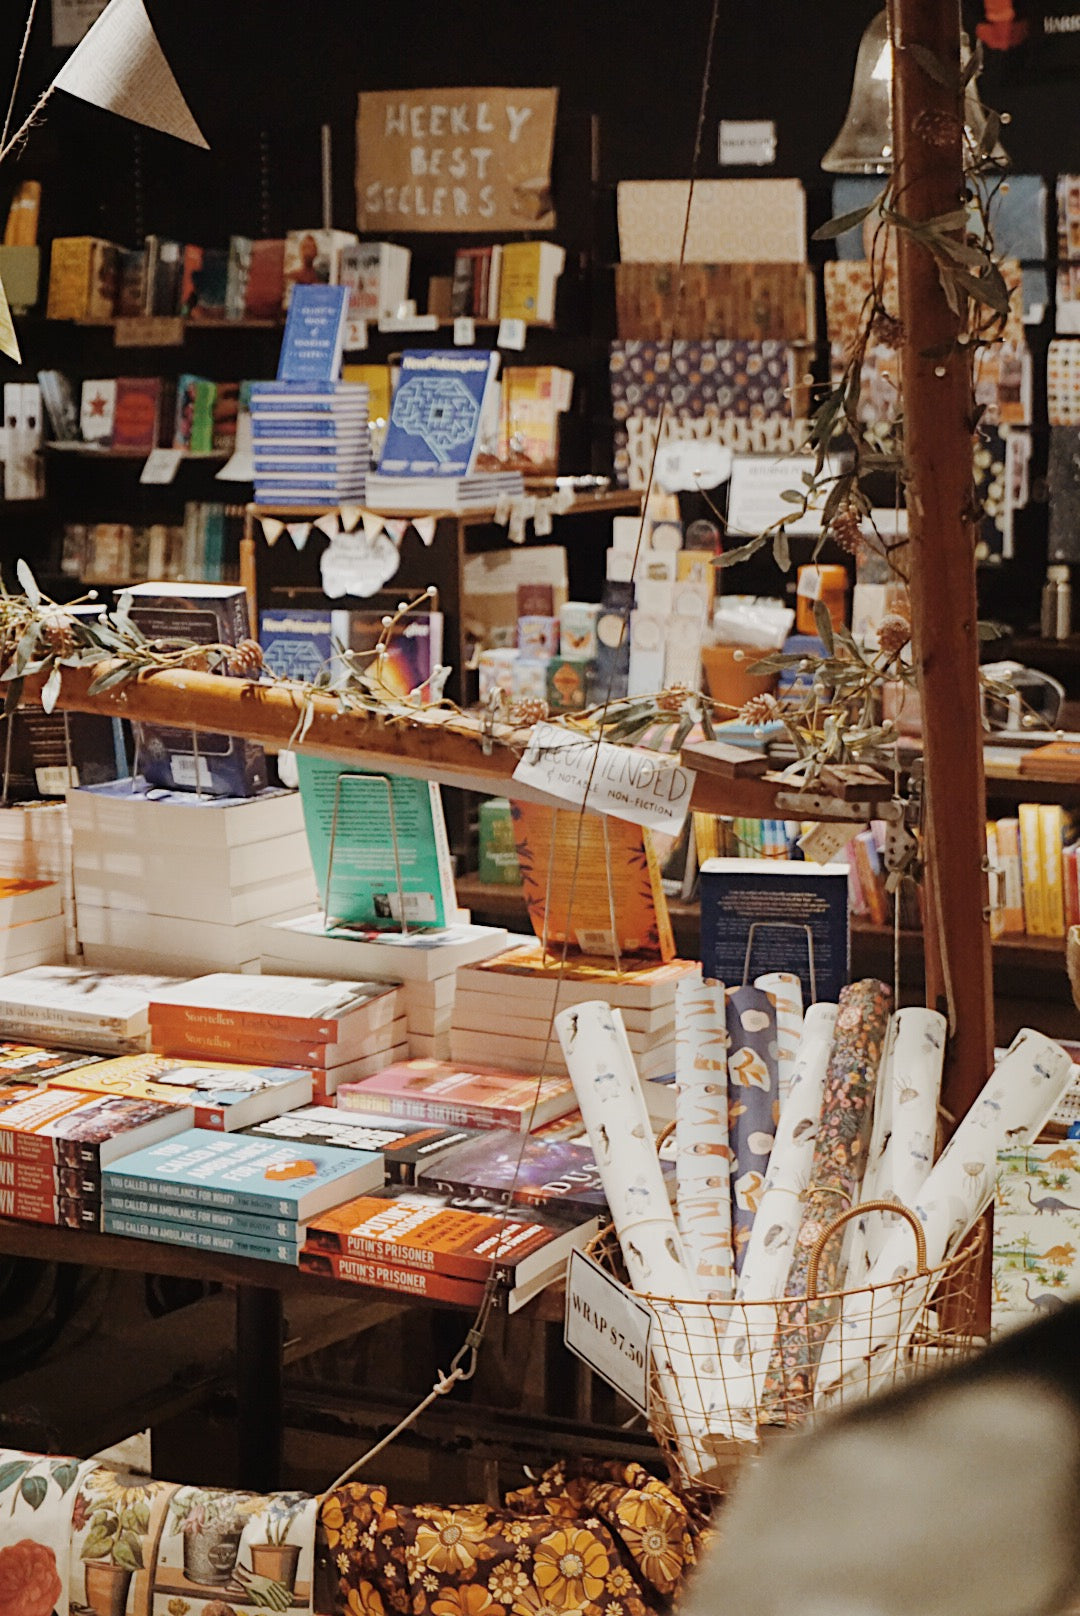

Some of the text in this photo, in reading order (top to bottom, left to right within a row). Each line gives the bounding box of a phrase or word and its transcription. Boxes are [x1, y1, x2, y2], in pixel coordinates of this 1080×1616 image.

[385, 102, 532, 143] WEEKLY
[410, 146, 494, 180] BEST
[607, 789, 673, 818] NON-FICTION
[184, 1009, 235, 1027] Storytellers
[184, 1031, 232, 1049] Storytellers
[221, 1162, 260, 1181] FOR
[110, 1178, 123, 1188] YOU
[124, 1179, 148, 1191] CALLED
[149, 1183, 158, 1193] AN
[159, 1184, 197, 1200] AMBULANCE
[199, 1190, 211, 1201] FOR
[212, 1192, 235, 1204] WHAT?
[111, 1198, 124, 1208] YOU
[124, 1199, 148, 1212] CALLED
[149, 1203, 158, 1213] AN
[159, 1204, 196, 1220] AMBULANCE
[198, 1210, 210, 1222] FOR
[212, 1212, 233, 1225] WHAT?
[112, 1220, 124, 1231] YOU
[125, 1221, 149, 1234] CALLED
[150, 1225, 159, 1236] AN
[160, 1227, 197, 1243] AMBULANCE
[199, 1234, 211, 1245] FOR
[212, 1236, 234, 1248] WHAT?
[347, 1236, 434, 1264] PUTIN'S PRISONER
[339, 1260, 426, 1288] PUTIN'S PRISONER
[572, 1291, 644, 1369] WRAP $7.50
